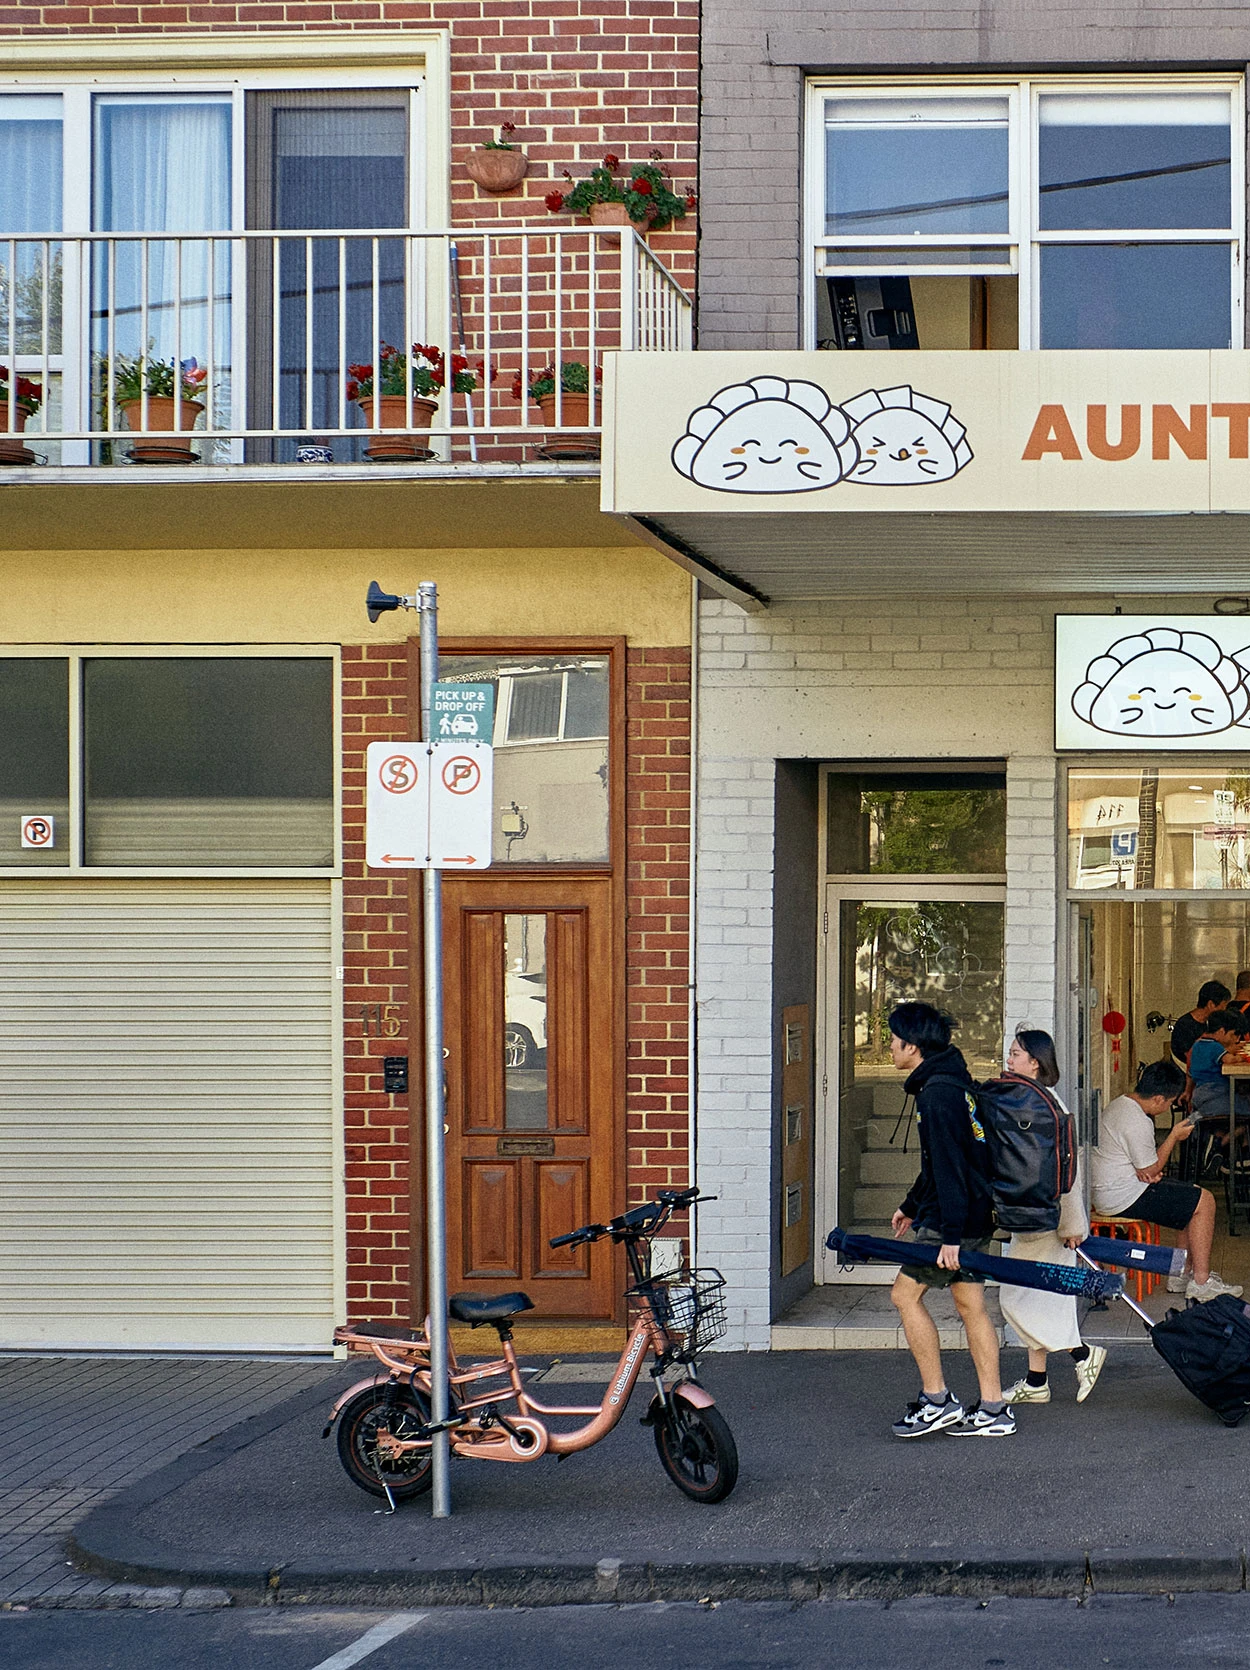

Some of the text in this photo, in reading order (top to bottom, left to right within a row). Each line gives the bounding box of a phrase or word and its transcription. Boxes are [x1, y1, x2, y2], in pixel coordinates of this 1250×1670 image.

[435, 690, 485, 701] PICK UP &
[435, 701, 485, 712] DROP OFF
[360, 1003, 401, 1037] 115
[613, 1333, 644, 1395] Lithium Bicycle
